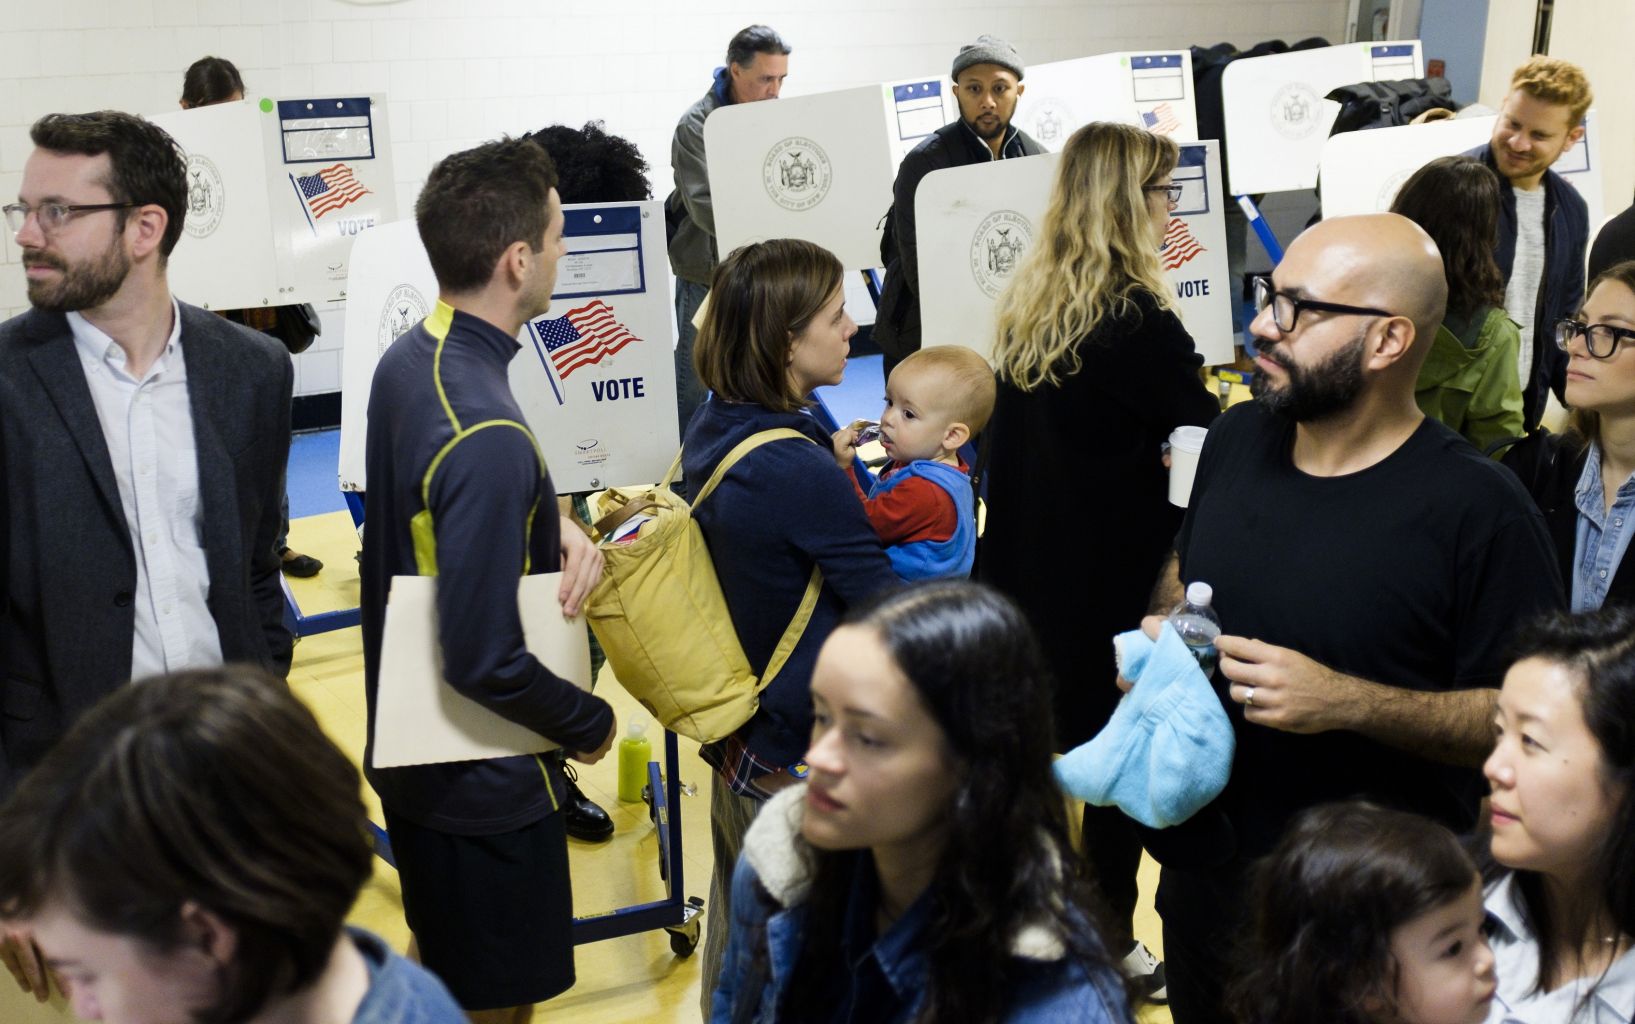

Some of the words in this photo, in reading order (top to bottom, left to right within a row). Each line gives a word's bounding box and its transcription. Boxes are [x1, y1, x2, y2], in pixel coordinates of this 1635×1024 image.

[337, 219, 374, 236] VOTE
[1177, 279, 1210, 298] VOTE
[591, 377, 644, 402] VOTE
